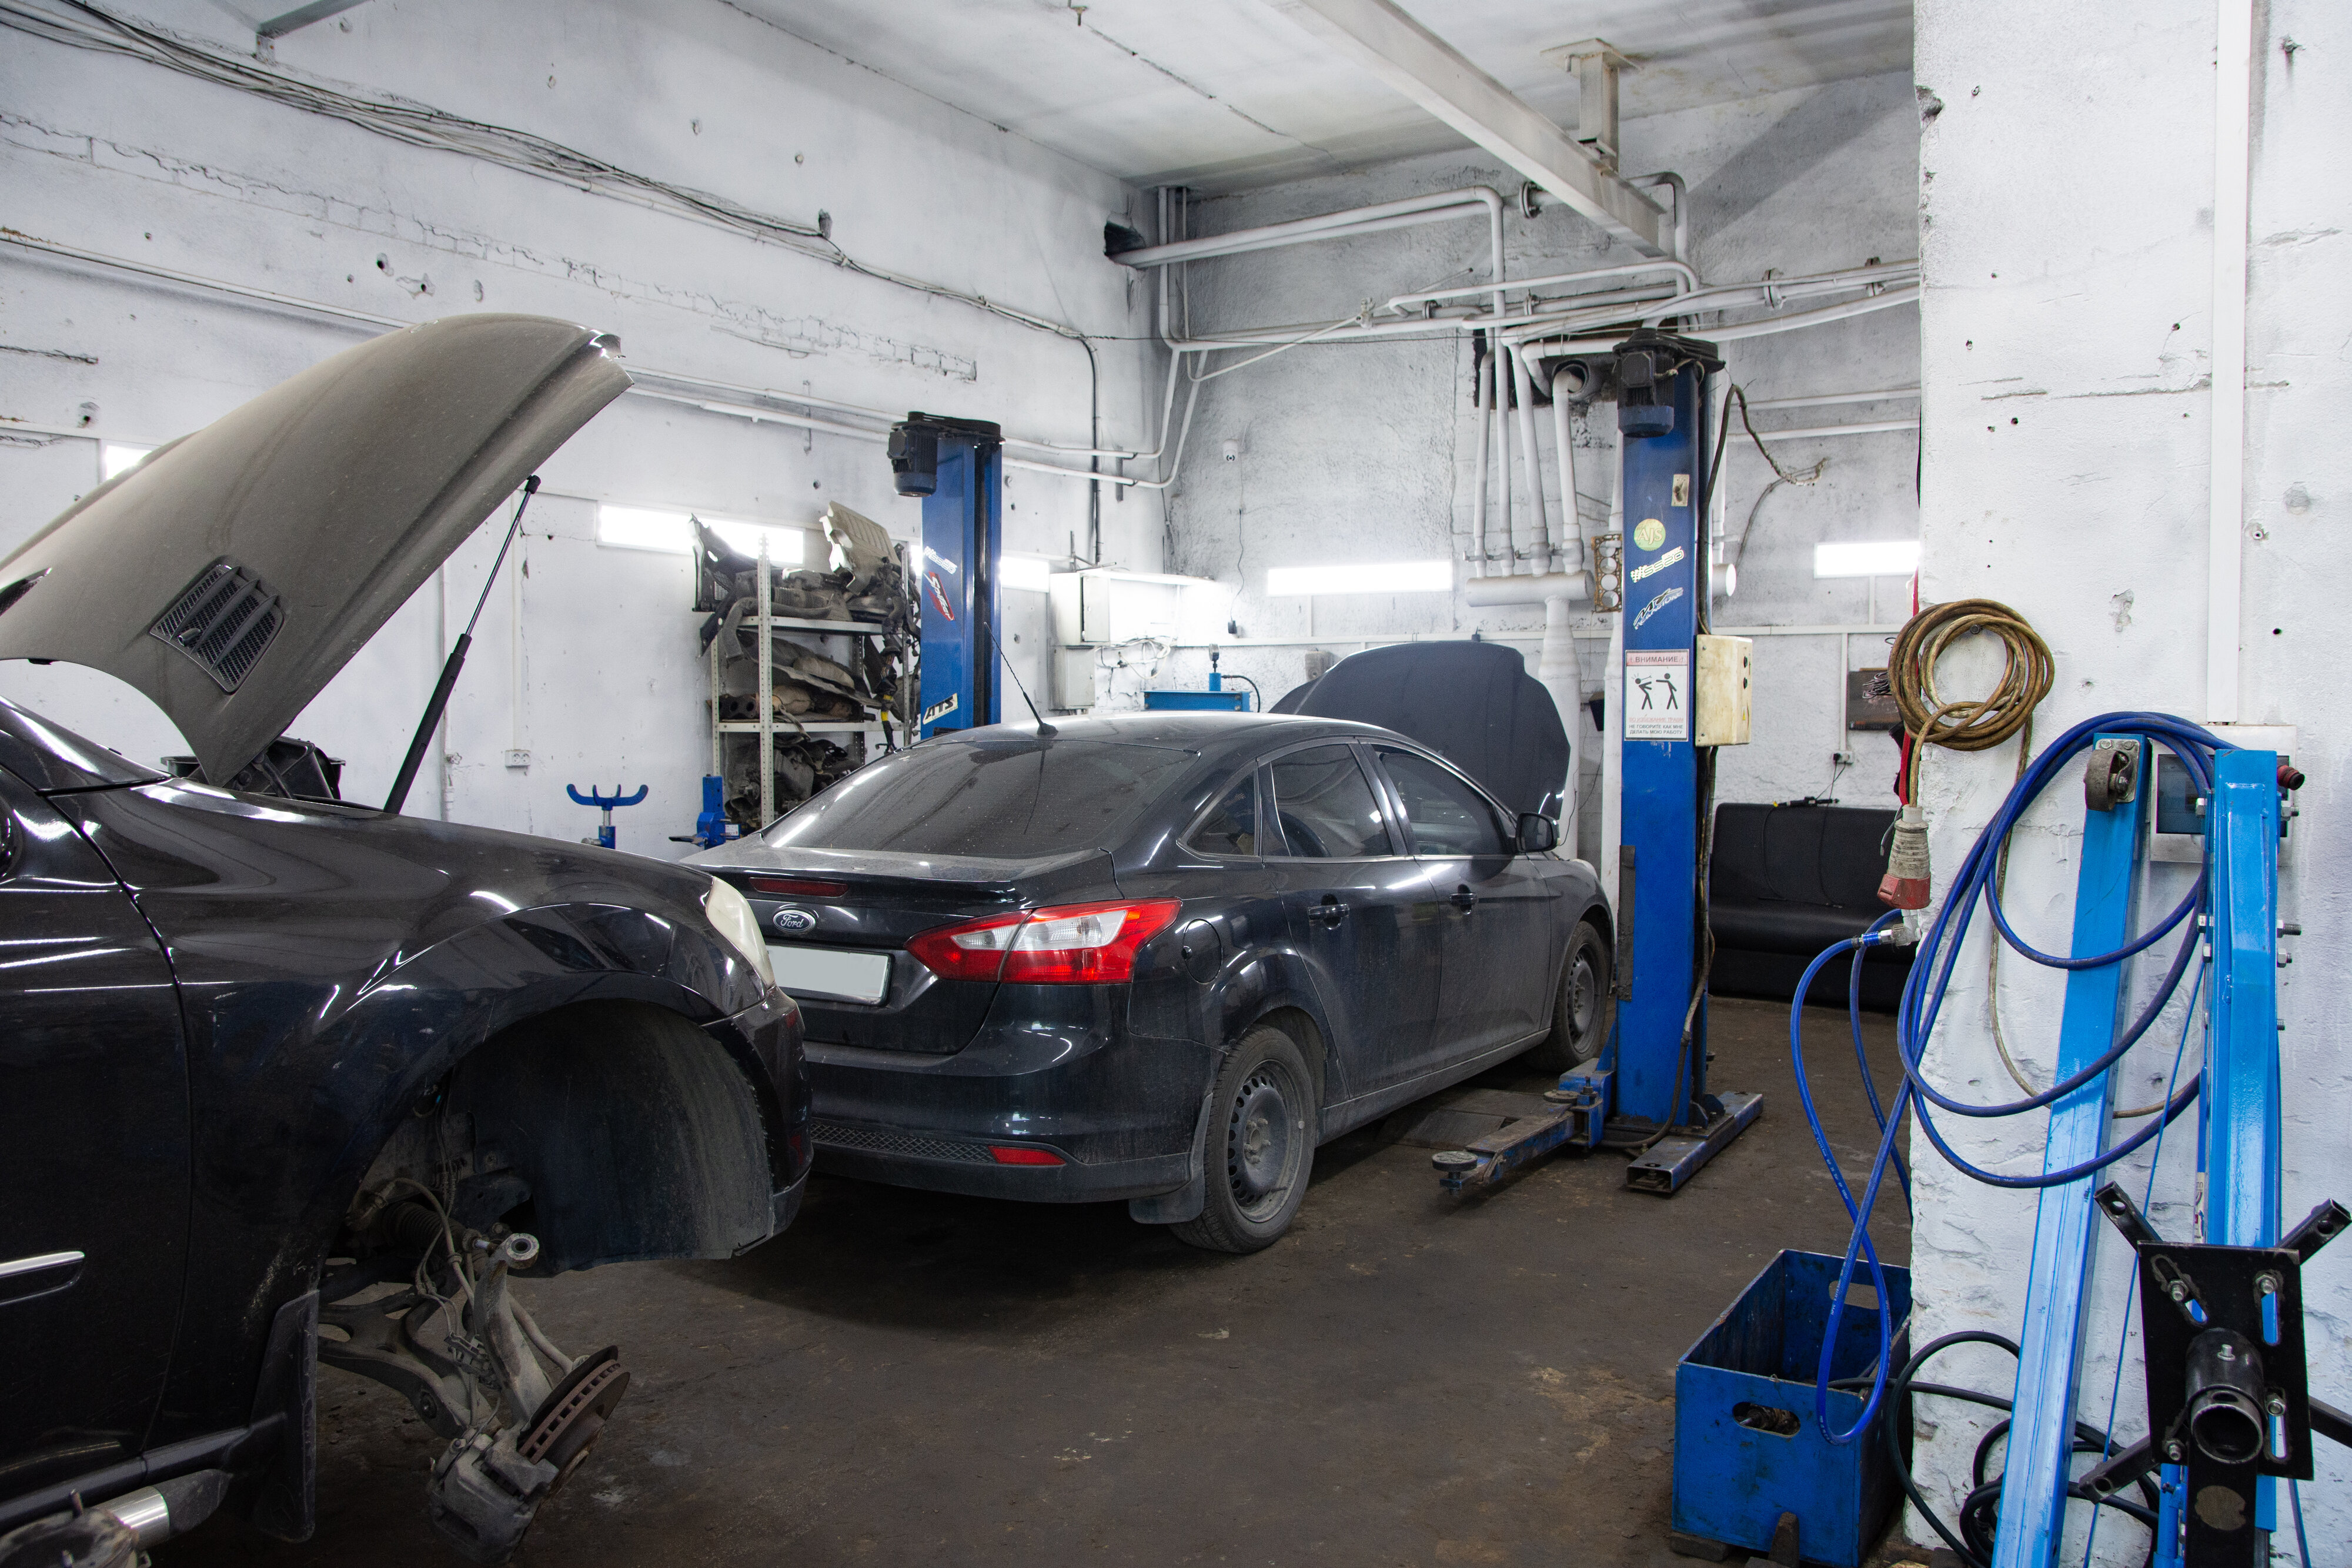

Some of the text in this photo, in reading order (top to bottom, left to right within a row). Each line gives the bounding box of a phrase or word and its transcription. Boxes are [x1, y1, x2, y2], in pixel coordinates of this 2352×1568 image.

[1638, 529, 1663, 544] AJS
[925, 696, 953, 720] ATS
[780, 914, 804, 928] Ford
